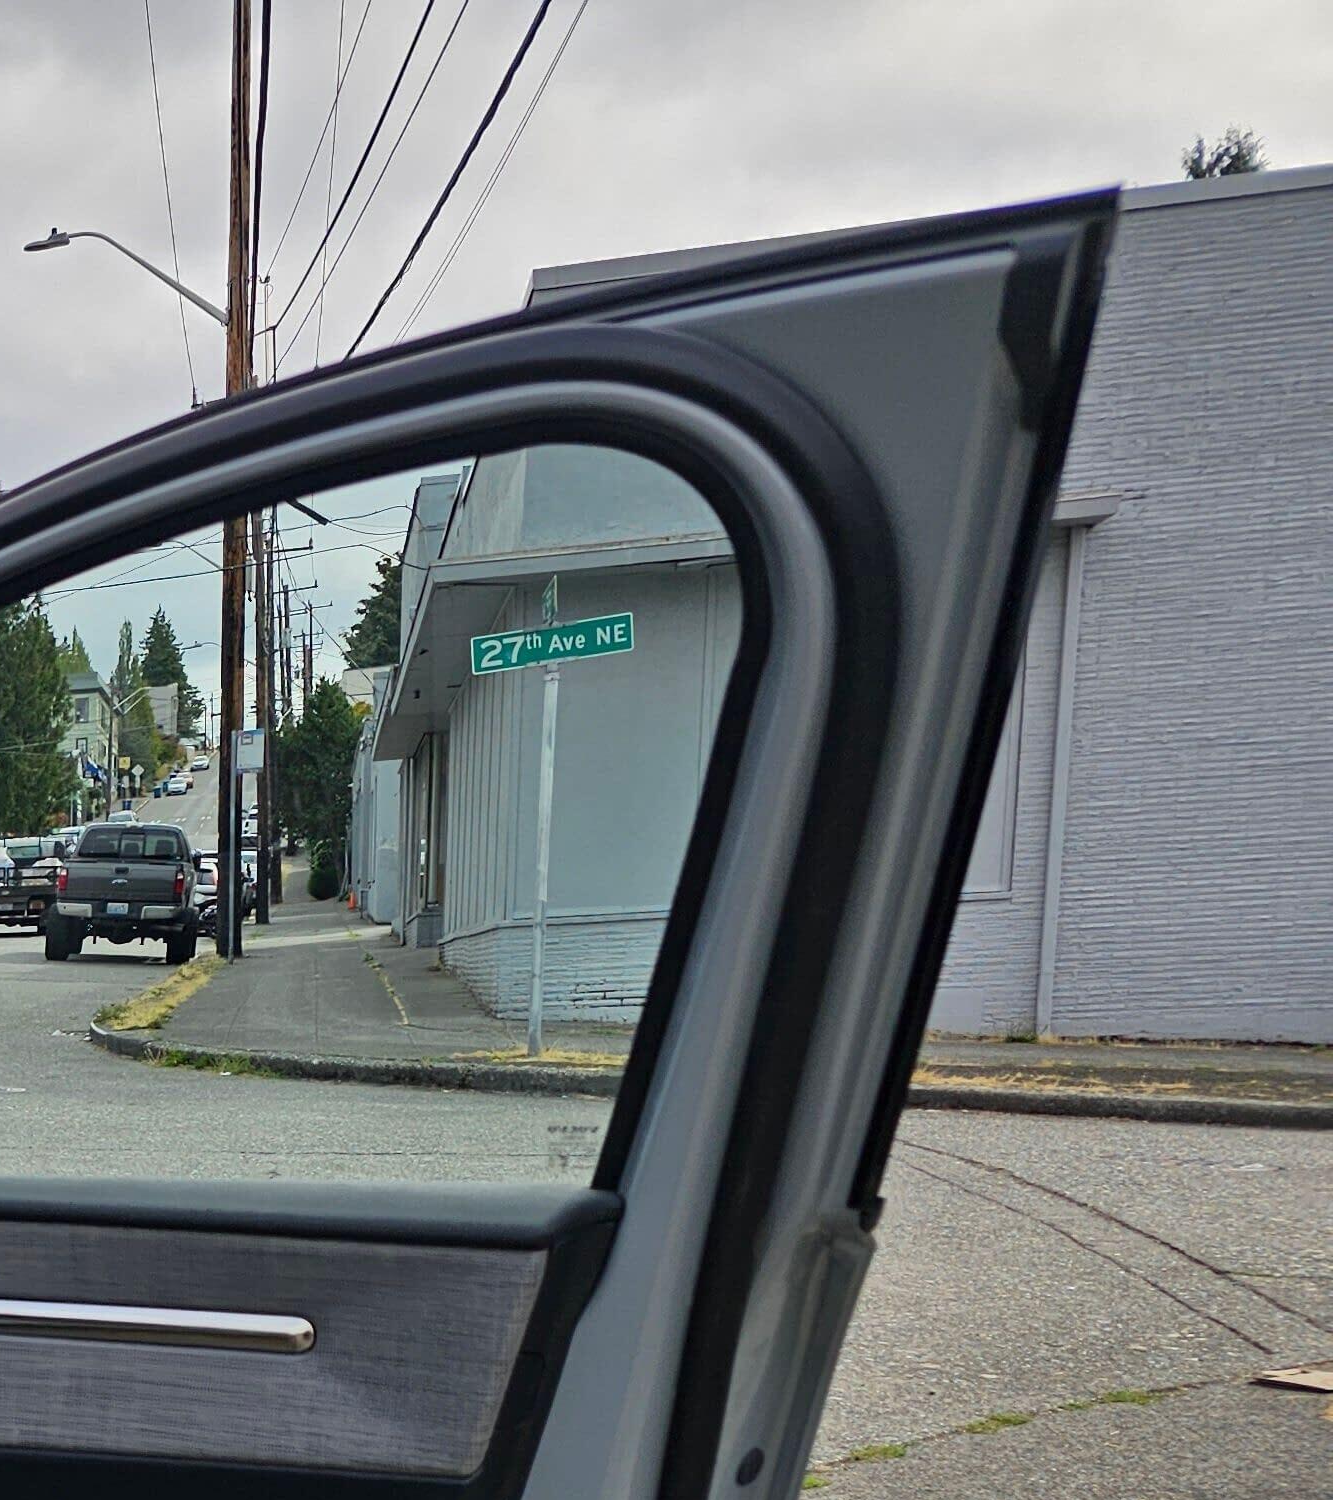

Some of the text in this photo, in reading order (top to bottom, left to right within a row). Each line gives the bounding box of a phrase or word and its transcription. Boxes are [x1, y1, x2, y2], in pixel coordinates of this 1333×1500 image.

[480, 623, 628, 669] 27th Ave NE
